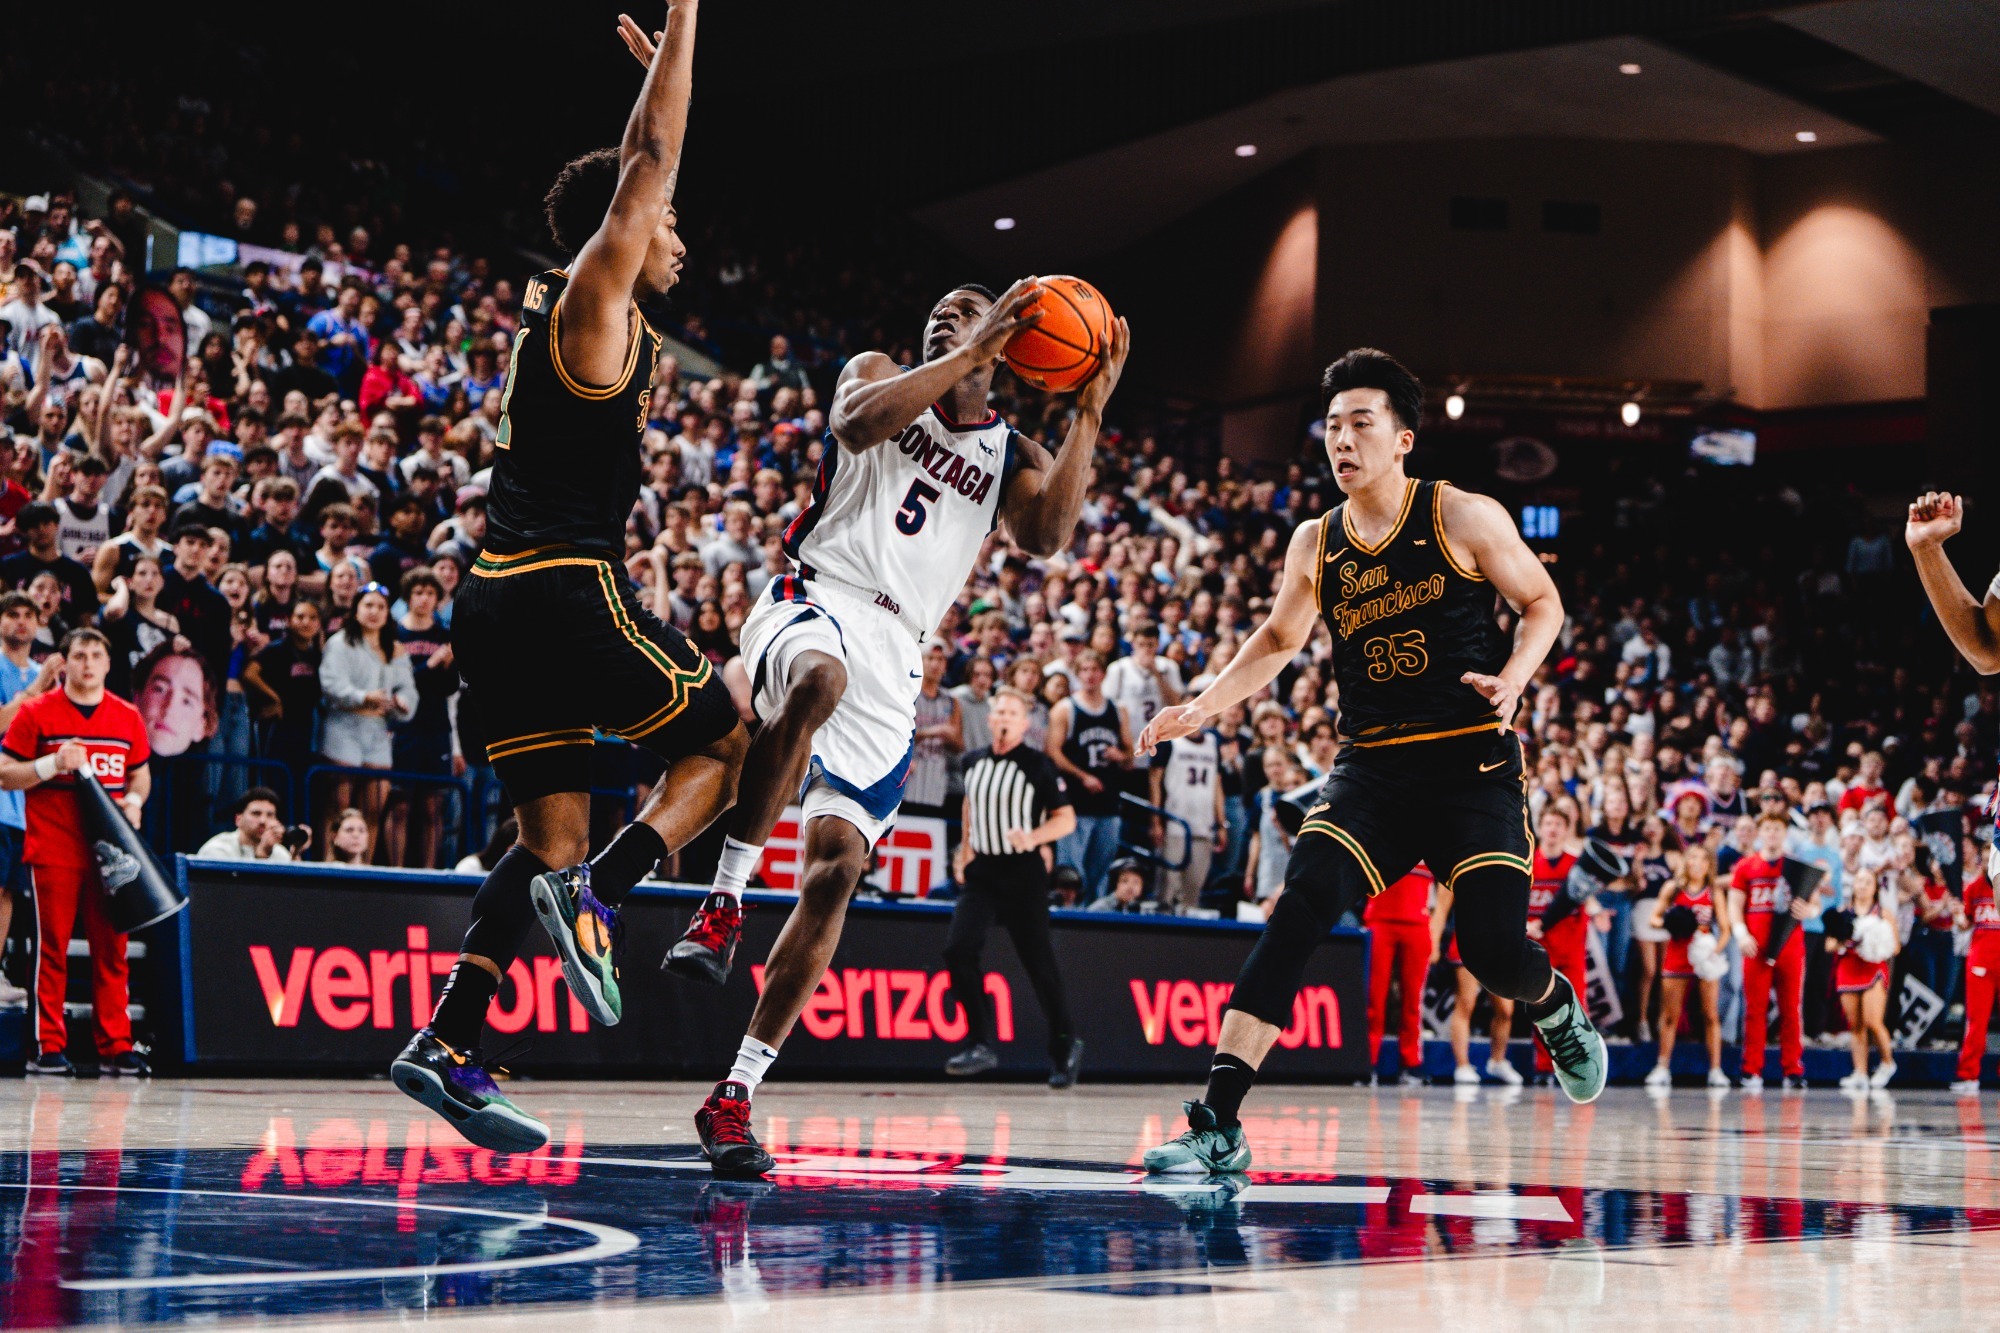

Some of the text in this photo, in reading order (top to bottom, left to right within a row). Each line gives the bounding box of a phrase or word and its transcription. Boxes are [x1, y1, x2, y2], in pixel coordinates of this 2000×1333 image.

[895, 477, 942, 536] 5
[1340, 561, 1389, 599] San
[873, 591, 900, 614] ZAGS
[1333, 573, 1445, 640] Francisco
[1364, 630, 1429, 682] 35
[84, 752, 126, 778] GS
[1187, 767, 1207, 785] 34
